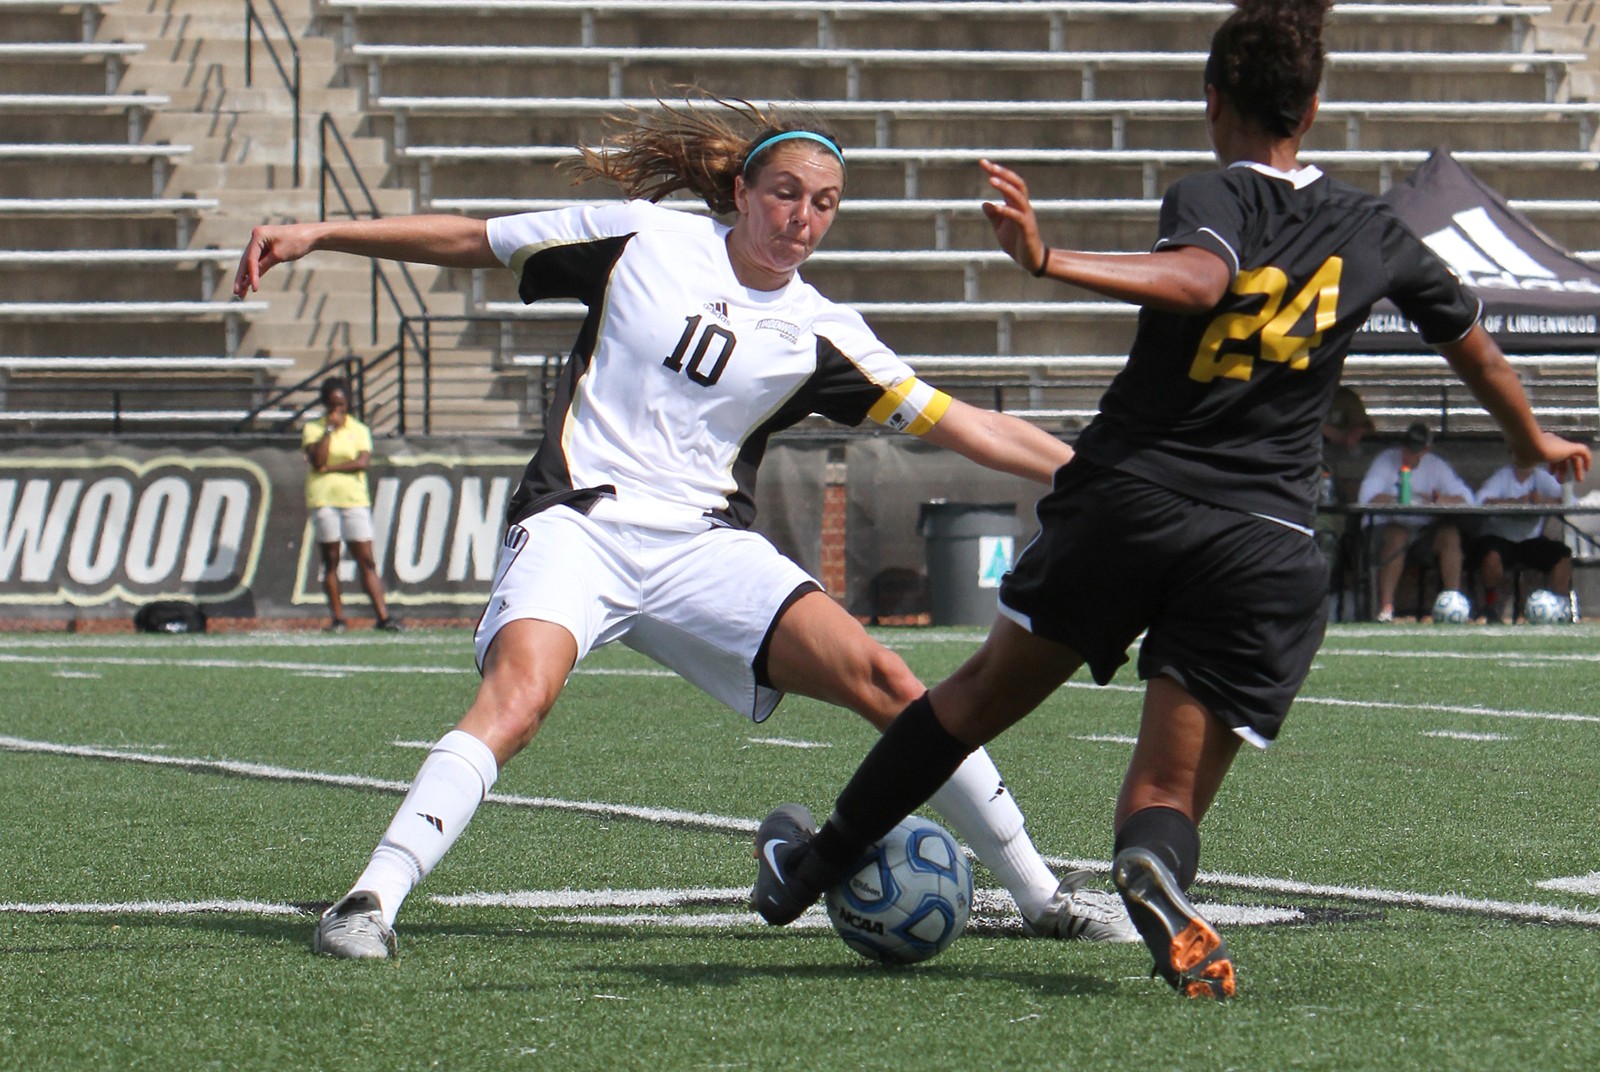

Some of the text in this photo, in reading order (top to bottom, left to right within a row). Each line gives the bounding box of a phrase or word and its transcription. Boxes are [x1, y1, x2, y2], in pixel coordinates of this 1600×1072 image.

[703, 302, 731, 326] adidas
[1188, 255, 1343, 383] 24
[1484, 314, 1503, 334] OF
[1507, 314, 1597, 334] LINDENWOOD
[662, 313, 737, 387] 10
[0, 476, 250, 585] WOOD
[852, 878, 880, 897] Wilson
[839, 906, 885, 936] NCAA
